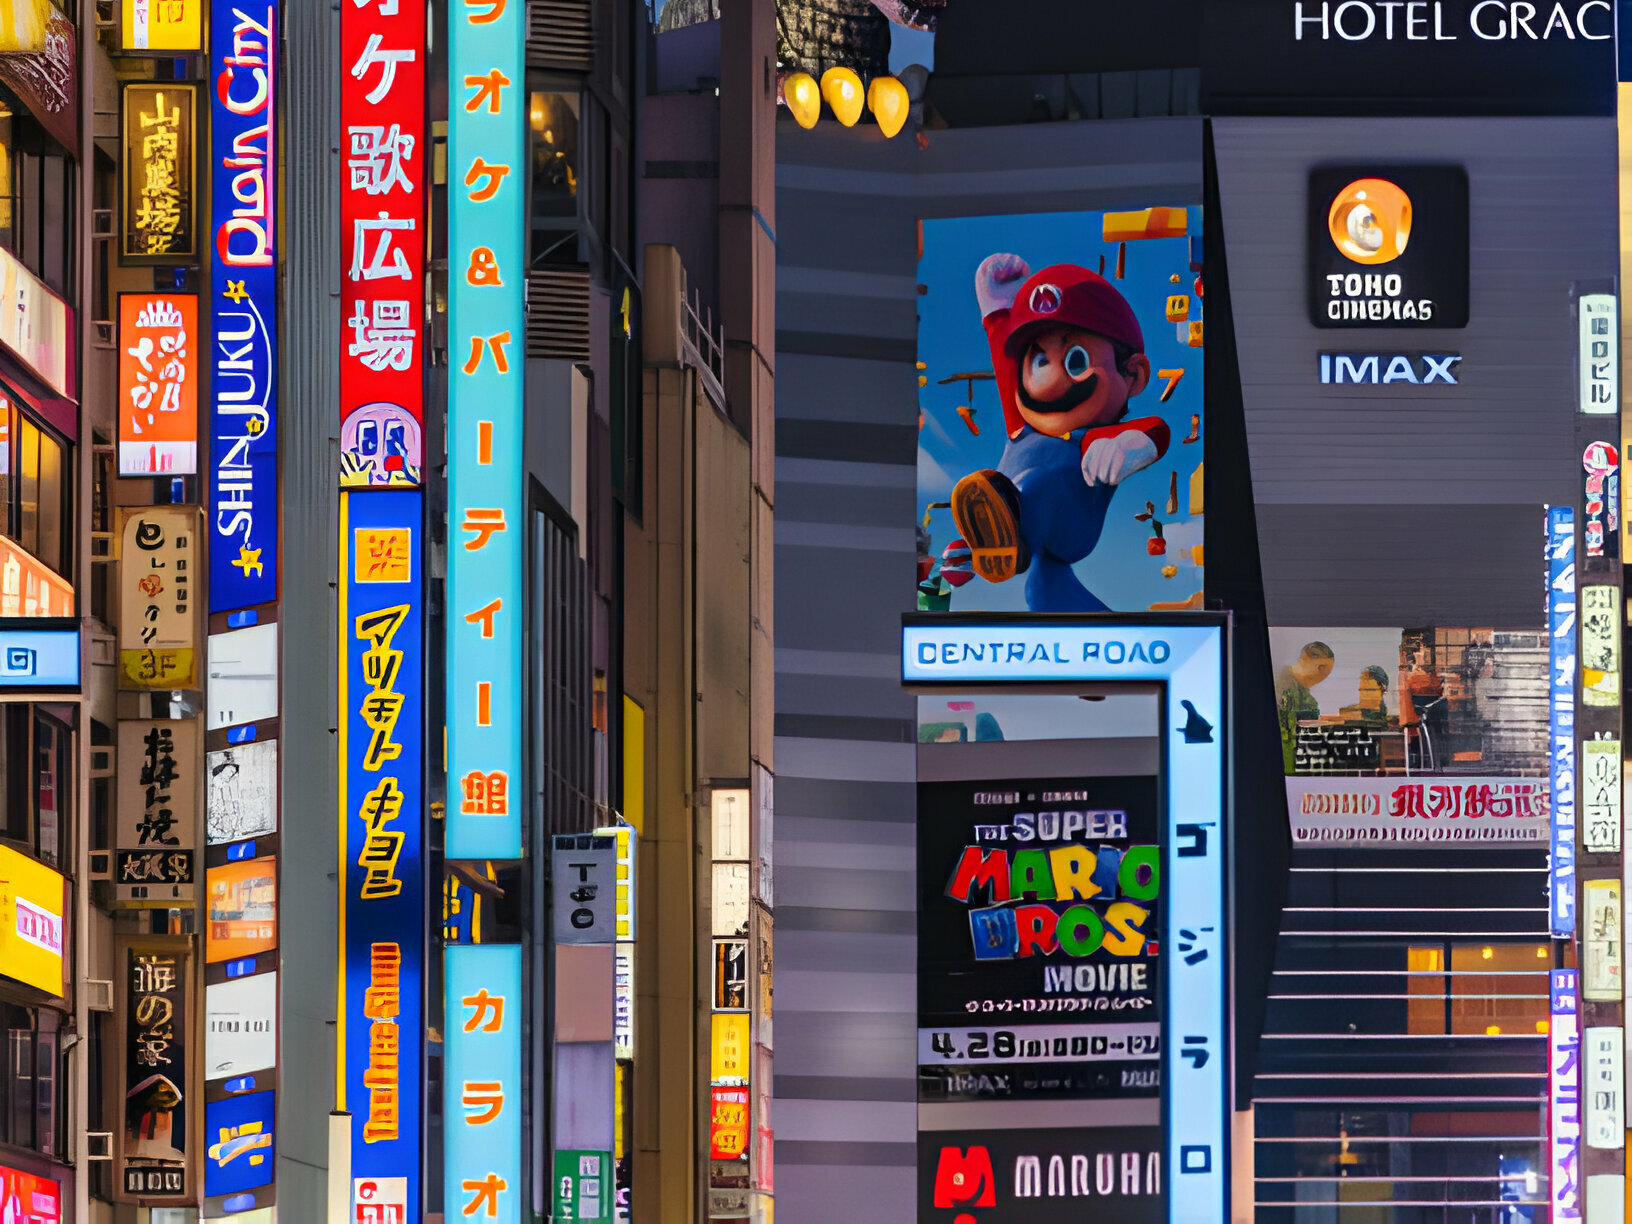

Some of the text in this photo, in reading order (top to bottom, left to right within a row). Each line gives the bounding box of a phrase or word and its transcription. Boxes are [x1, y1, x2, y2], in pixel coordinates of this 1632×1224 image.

[1294, 0, 1611, 41] HOTEL GRAC
[1326, 273, 1402, 297] TOHO
[1327, 298, 1434, 321] CINEMAS
[1319, 354, 1461, 385] IMAX
[217, 312, 269, 537] SHINJUKU
[1012, 809, 1128, 842] SUPER
[1044, 963, 1148, 993] MOVIE
[462, 988, 508, 1217] カラオ
